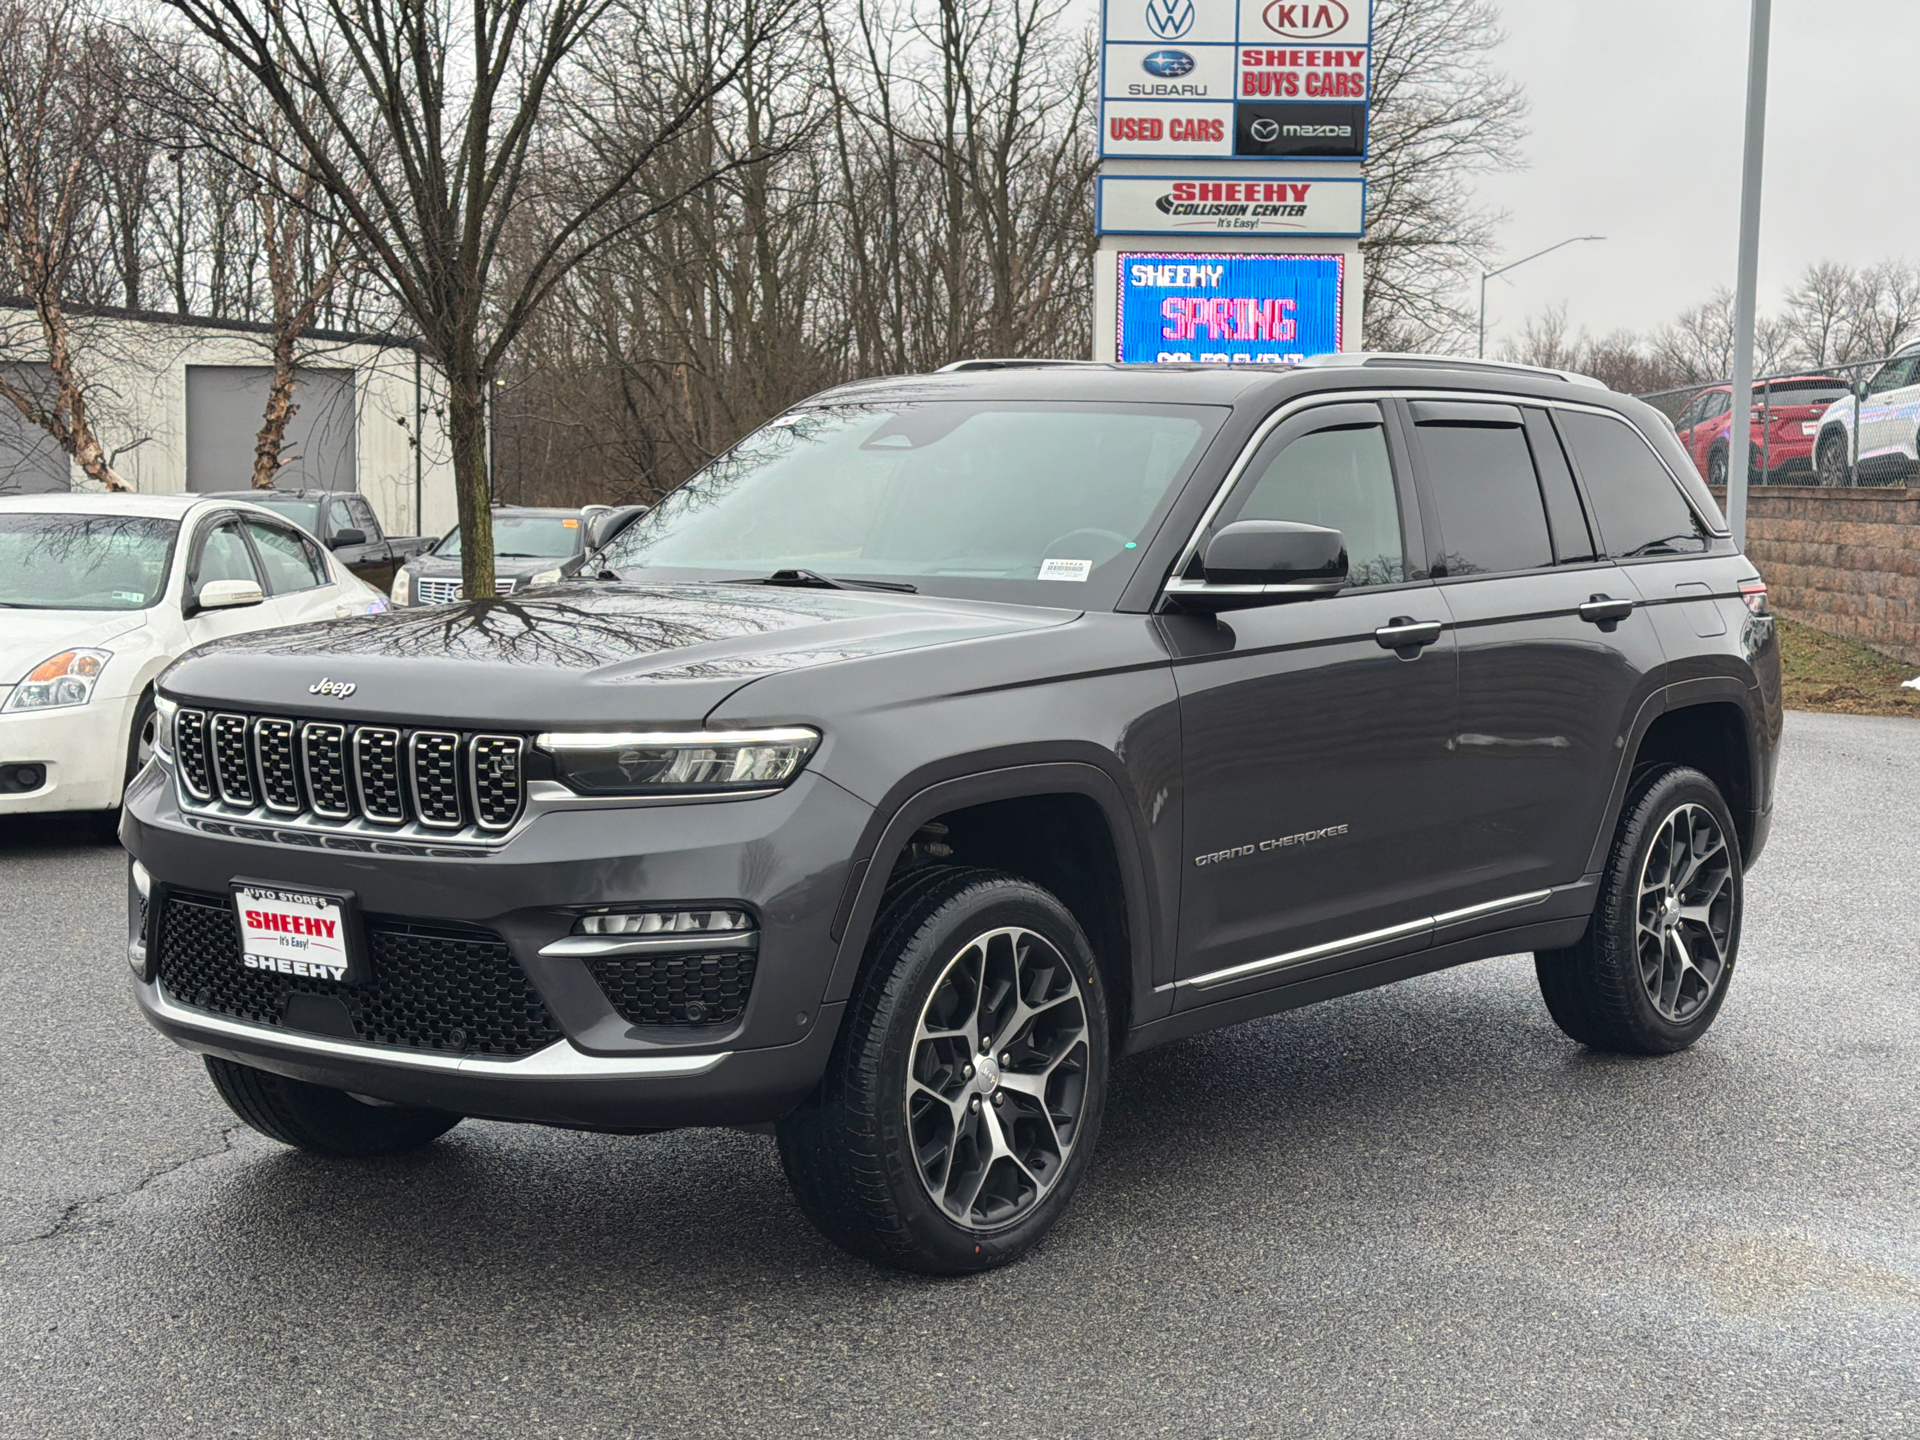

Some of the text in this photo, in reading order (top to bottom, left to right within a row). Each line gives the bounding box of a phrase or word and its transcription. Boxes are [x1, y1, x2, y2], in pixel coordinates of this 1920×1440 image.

[1278, 5, 1334, 28] KIA
[1242, 50, 1365, 67] SHEEHY
[1128, 84, 1207, 96] SUBARU
[1242, 72, 1364, 97] BUYS CARS
[1110, 118, 1224, 142] USED CARS
[1172, 183, 1311, 202] SHEEHY
[1172, 203, 1307, 217] COLLISION CENTER
[1217, 218, 1259, 229] It's Easy!
[1131, 264, 1223, 287] SHEEHY
[1161, 296, 1297, 341] SPRING
[308, 677, 357, 699] Jeep
[1195, 823, 1349, 867] GRAND CHEROKEE
[243, 888, 276, 900] AUTO
[245, 910, 336, 939] SHEEHY
[279, 935, 309, 951] It's Easy!
[243, 954, 346, 981] SHEEHY
